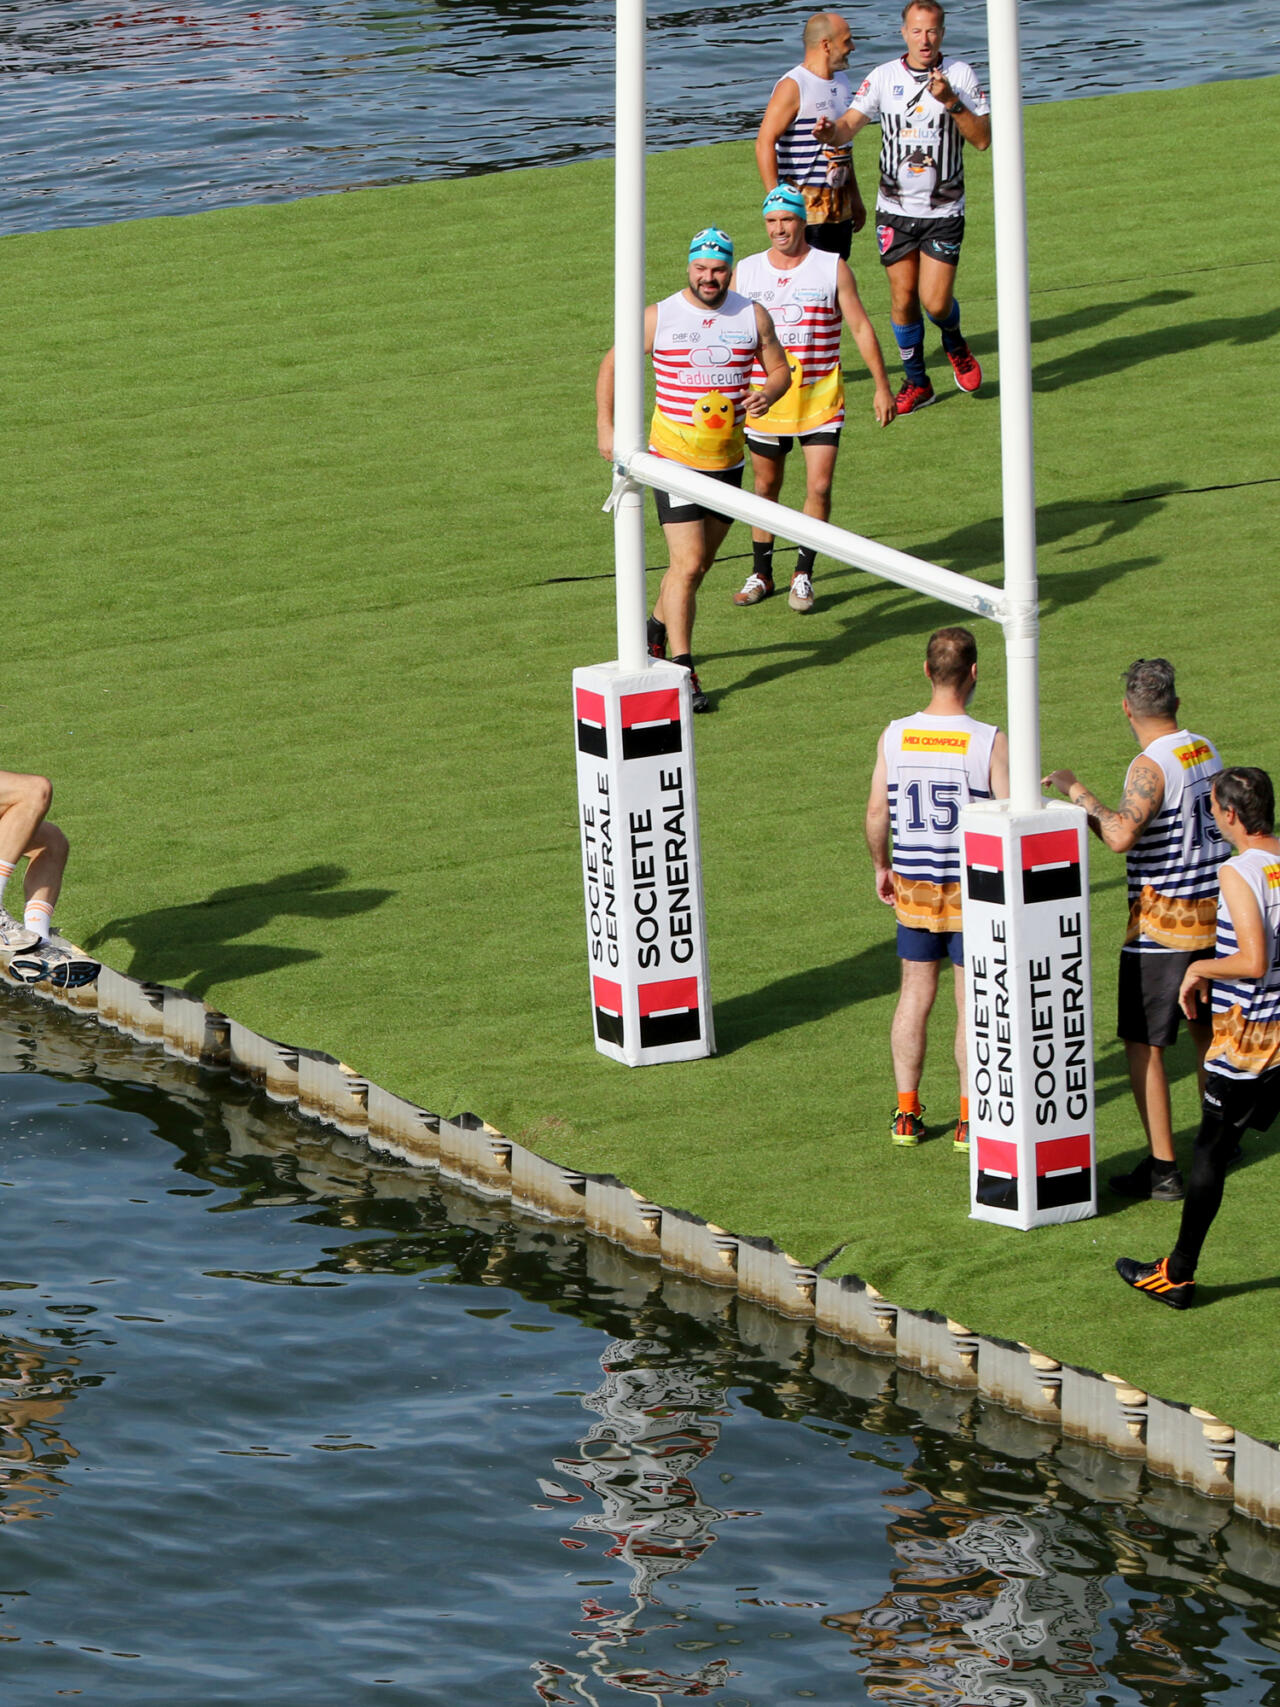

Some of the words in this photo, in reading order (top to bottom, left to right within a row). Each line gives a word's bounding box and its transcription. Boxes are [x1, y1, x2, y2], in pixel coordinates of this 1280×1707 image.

[678, 369, 744, 385] Caduceum
[904, 780, 961, 834] 15
[921, 736, 967, 748] OLYMPIQUE
[583, 803, 604, 963] SOCIETE
[597, 771, 619, 968] GENERALE
[629, 808, 660, 970] SOCIETE
[659, 766, 694, 965] GENERALE
[971, 954, 993, 1124] SOCIETE
[991, 918, 1015, 1128] GENERALE
[1028, 955, 1057, 1127] SOCIETE
[1059, 911, 1089, 1122] GENERALE
